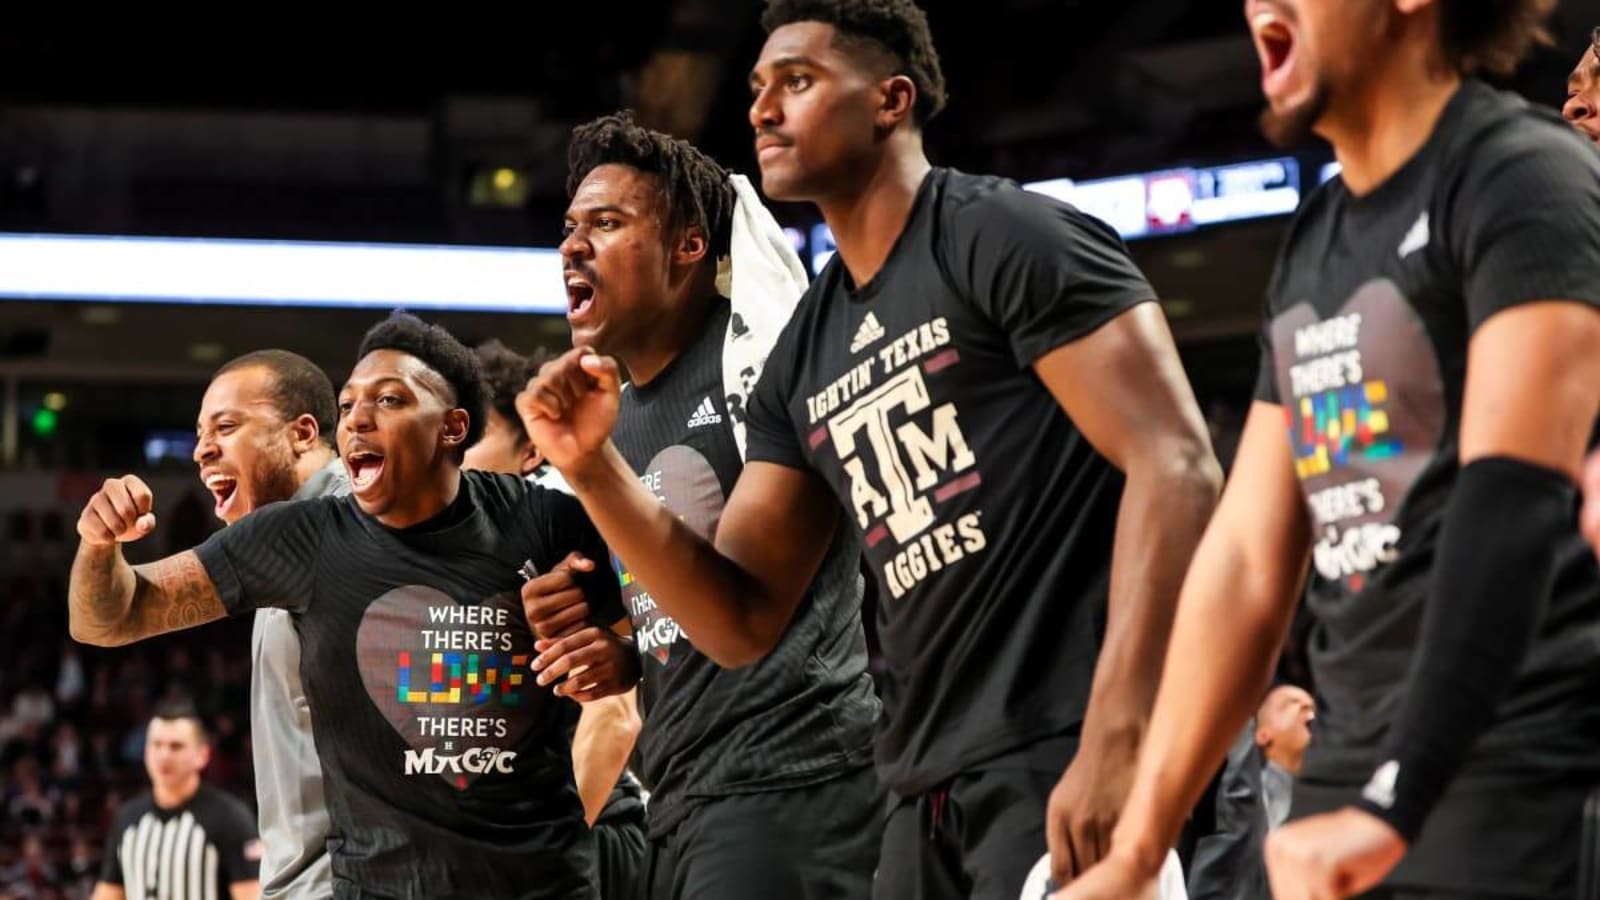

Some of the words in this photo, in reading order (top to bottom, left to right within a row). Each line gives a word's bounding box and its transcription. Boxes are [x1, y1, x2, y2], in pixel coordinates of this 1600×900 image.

[806, 356, 875, 424] IGHTIN'
[879, 317, 951, 373] TEXAS
[687, 414, 722, 429] adidas
[428, 606, 509, 627] WHERE
[421, 630, 513, 651] THERE'S
[397, 652, 528, 704] LOVE
[416, 717, 507, 738] THERE'S
[403, 747, 518, 776] MAGIC
